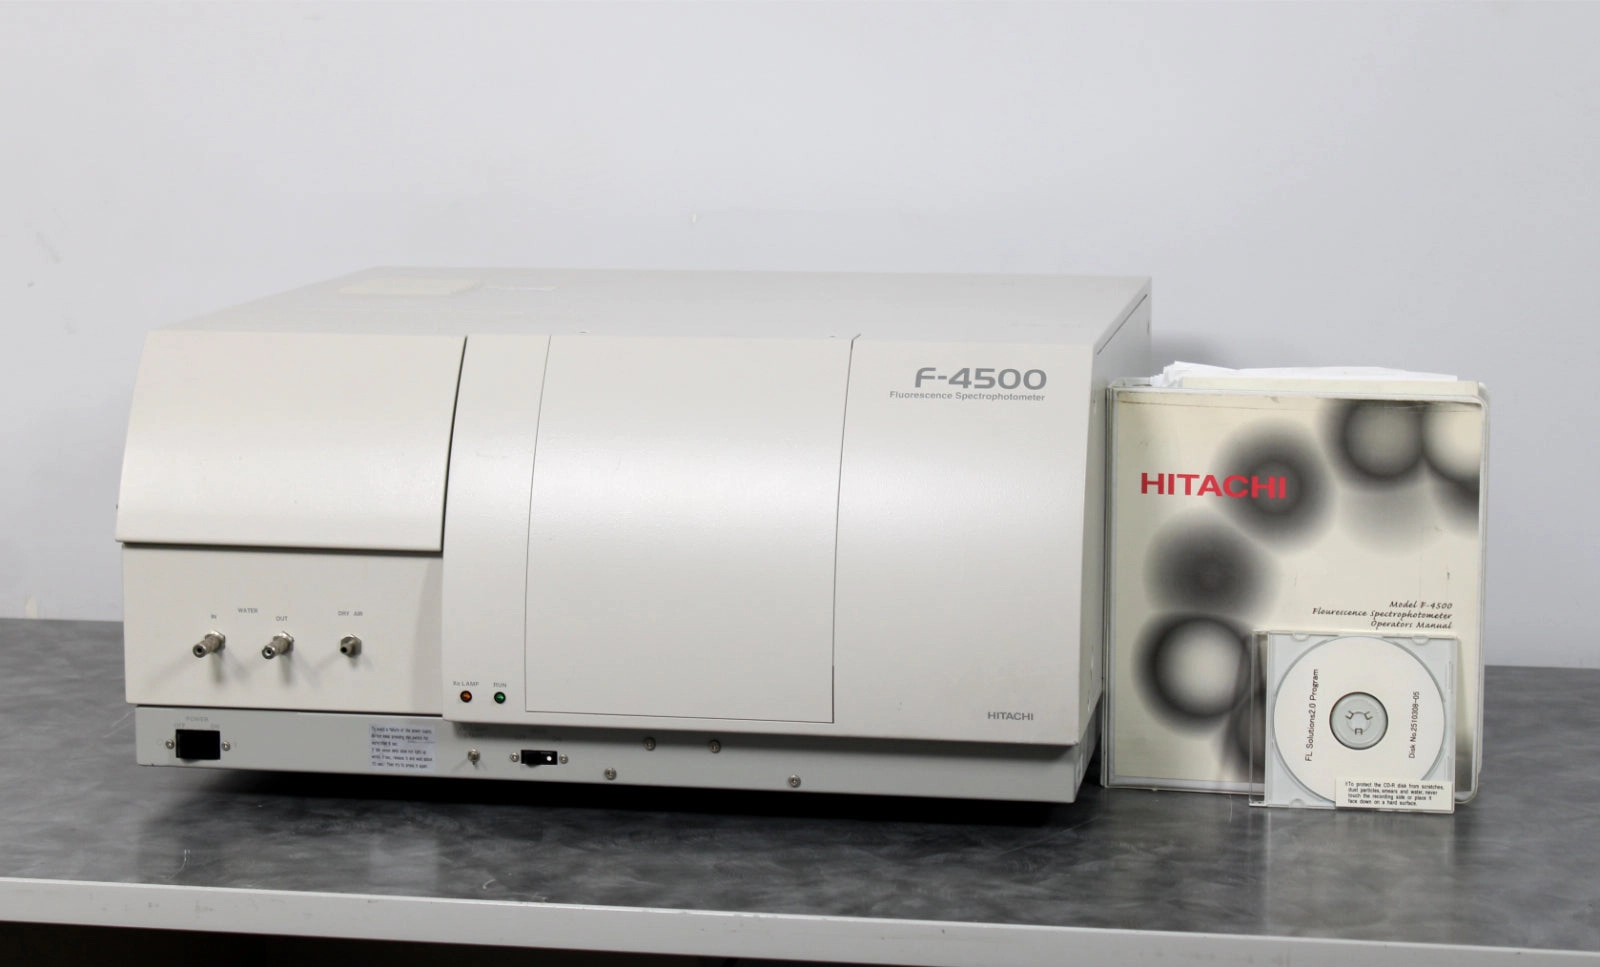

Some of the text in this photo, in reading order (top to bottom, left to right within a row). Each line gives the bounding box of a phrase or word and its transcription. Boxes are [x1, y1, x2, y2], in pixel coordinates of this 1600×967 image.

[915, 367, 1047, 390] F-4500
[889, 390, 1045, 401] Fluorescence Spectrophotometer
[1141, 472, 1286, 499] HITACHI
[1389, 600, 1453, 609] Model F-4500
[1370, 609, 1453, 620] Spectrophotometer
[1371, 620, 1452, 629] Operators Manual
[987, 711, 1034, 720] HITACHI
[1305, 751, 1312, 761] FL
[1309, 669, 1319, 701] Program
